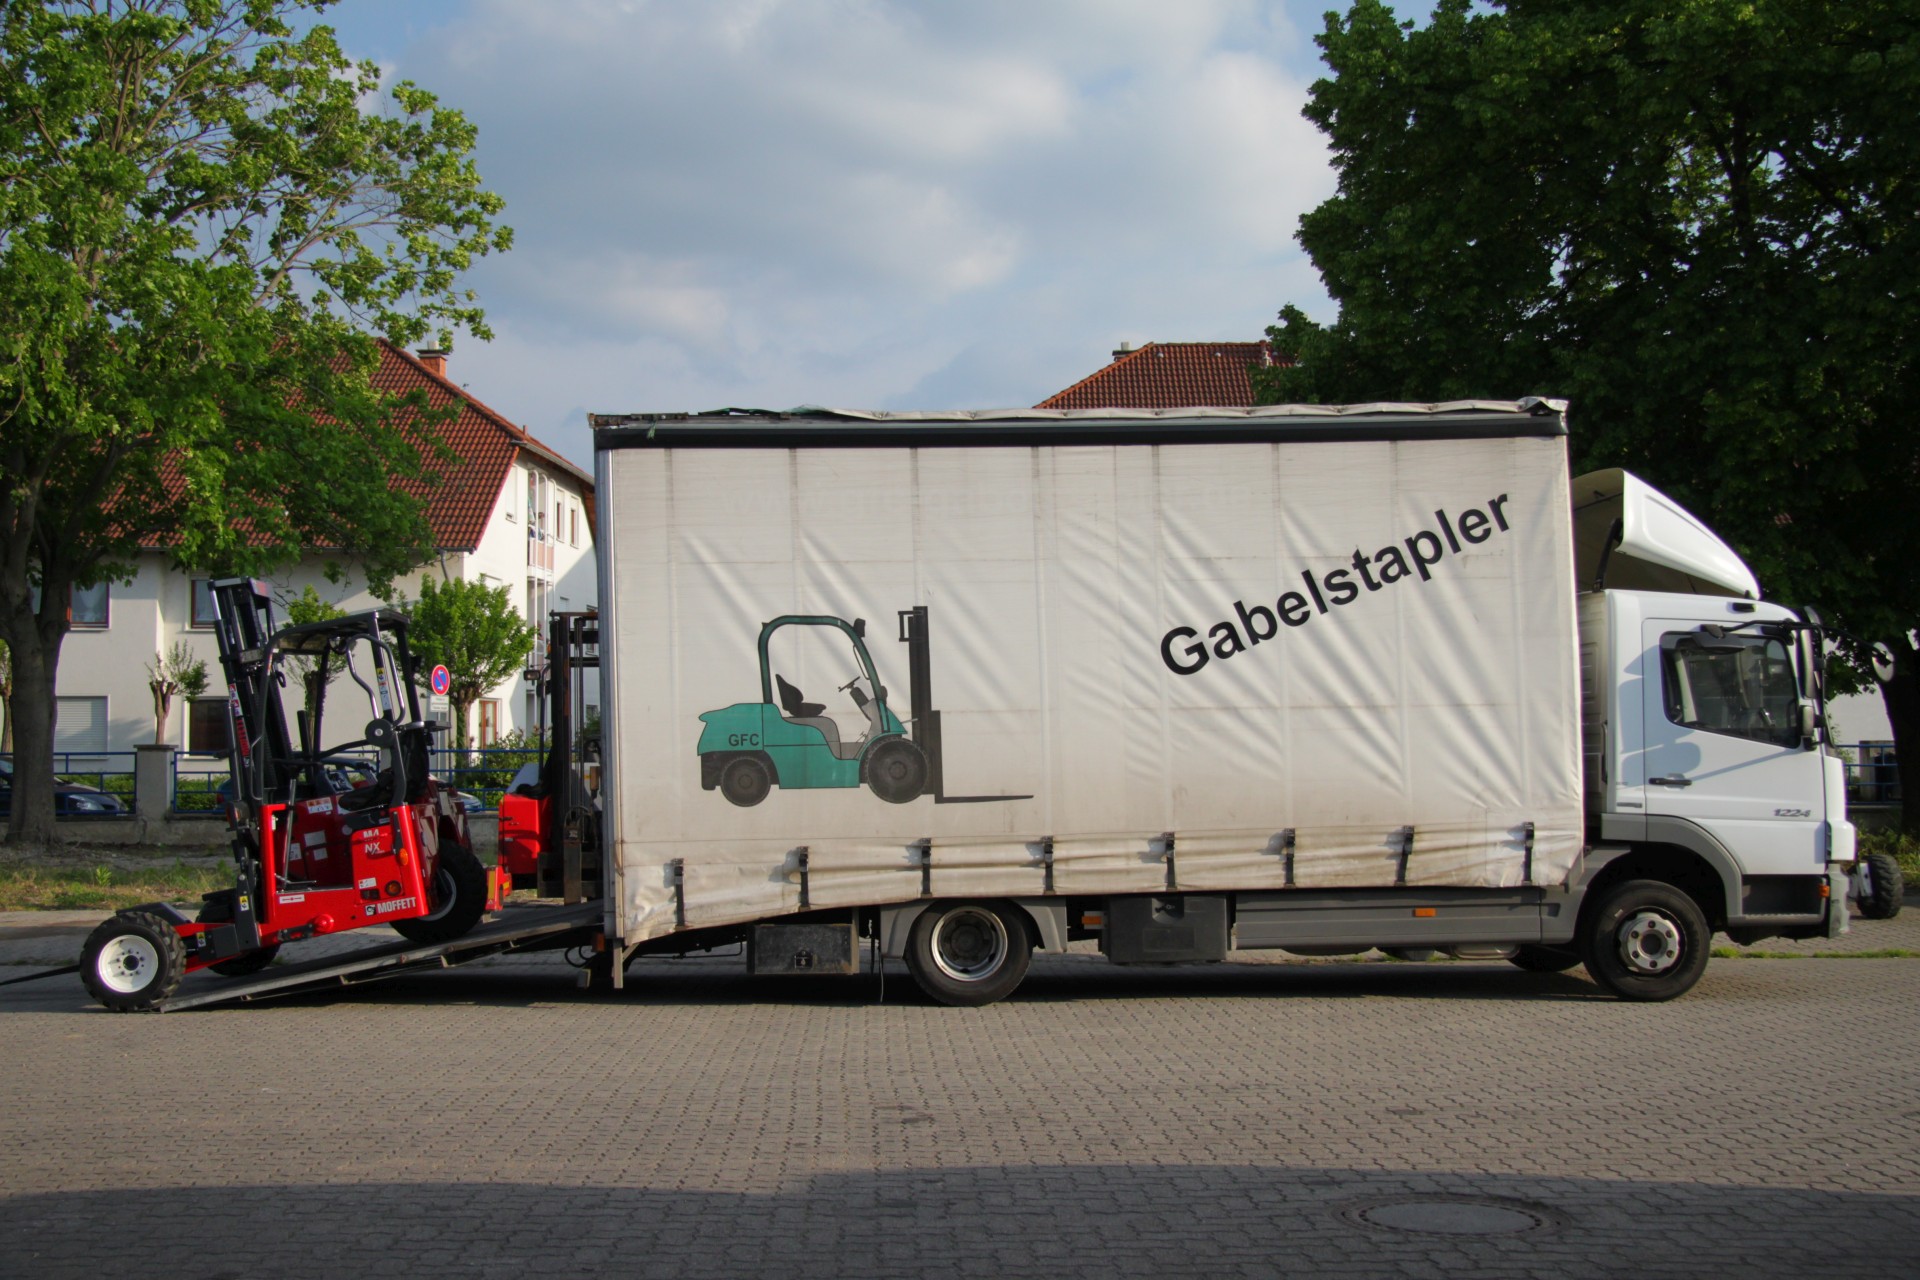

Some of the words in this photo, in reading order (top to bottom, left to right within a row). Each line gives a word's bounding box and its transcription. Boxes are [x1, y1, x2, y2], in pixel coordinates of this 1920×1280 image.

[1160, 493, 1510, 675] Gabelstapler
[728, 733, 759, 746] GFC
[1774, 808, 1811, 817] 1224
[377, 897, 416, 914] MOFFETT
